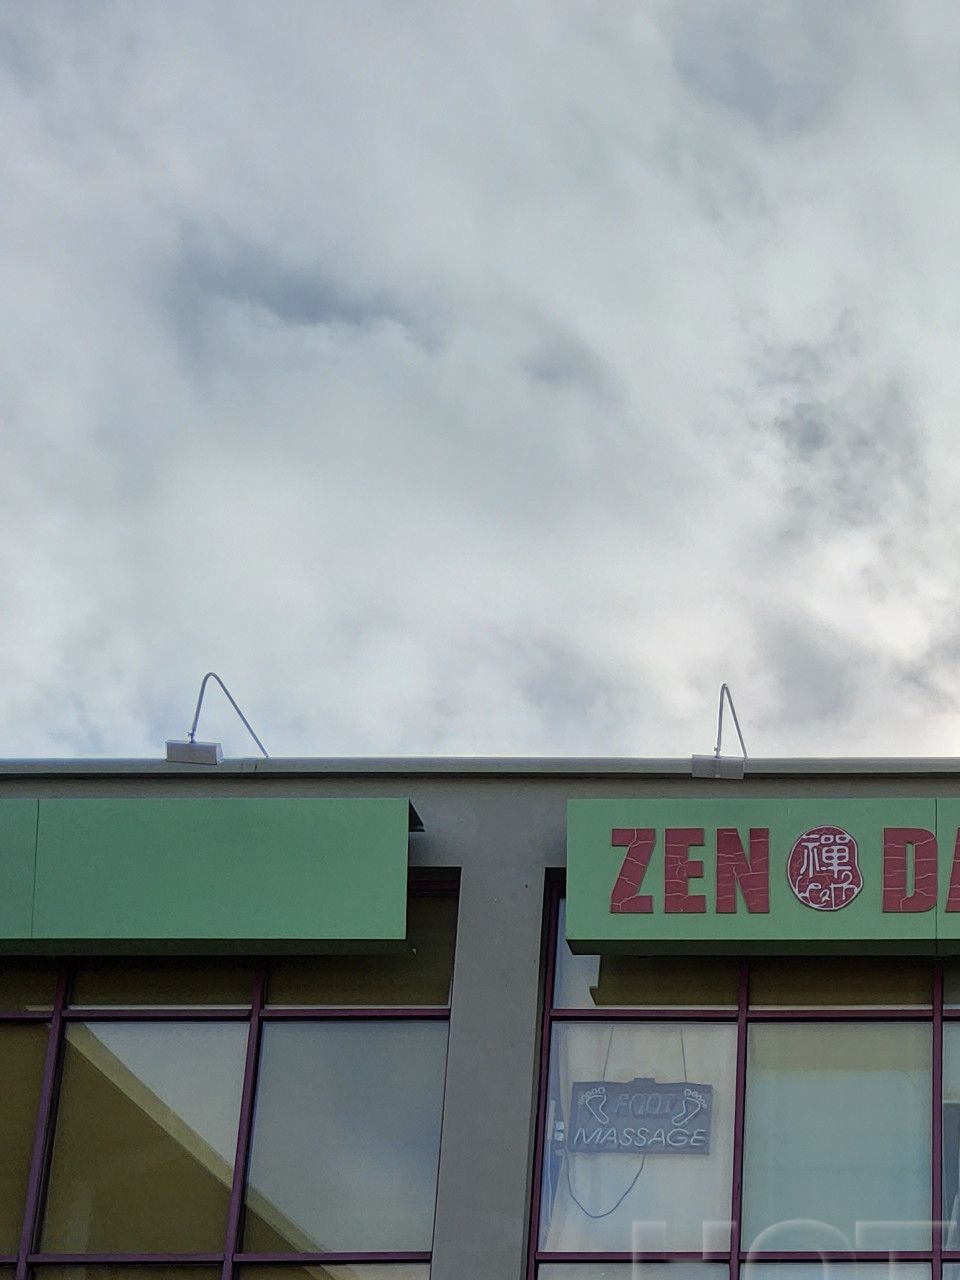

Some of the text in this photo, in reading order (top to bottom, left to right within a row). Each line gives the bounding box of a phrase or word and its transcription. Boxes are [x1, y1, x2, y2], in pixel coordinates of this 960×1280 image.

[610, 828, 770, 914] ZEN
[615, 1093, 678, 1115] FOOT
[573, 1127, 707, 1147] MASSAGE
